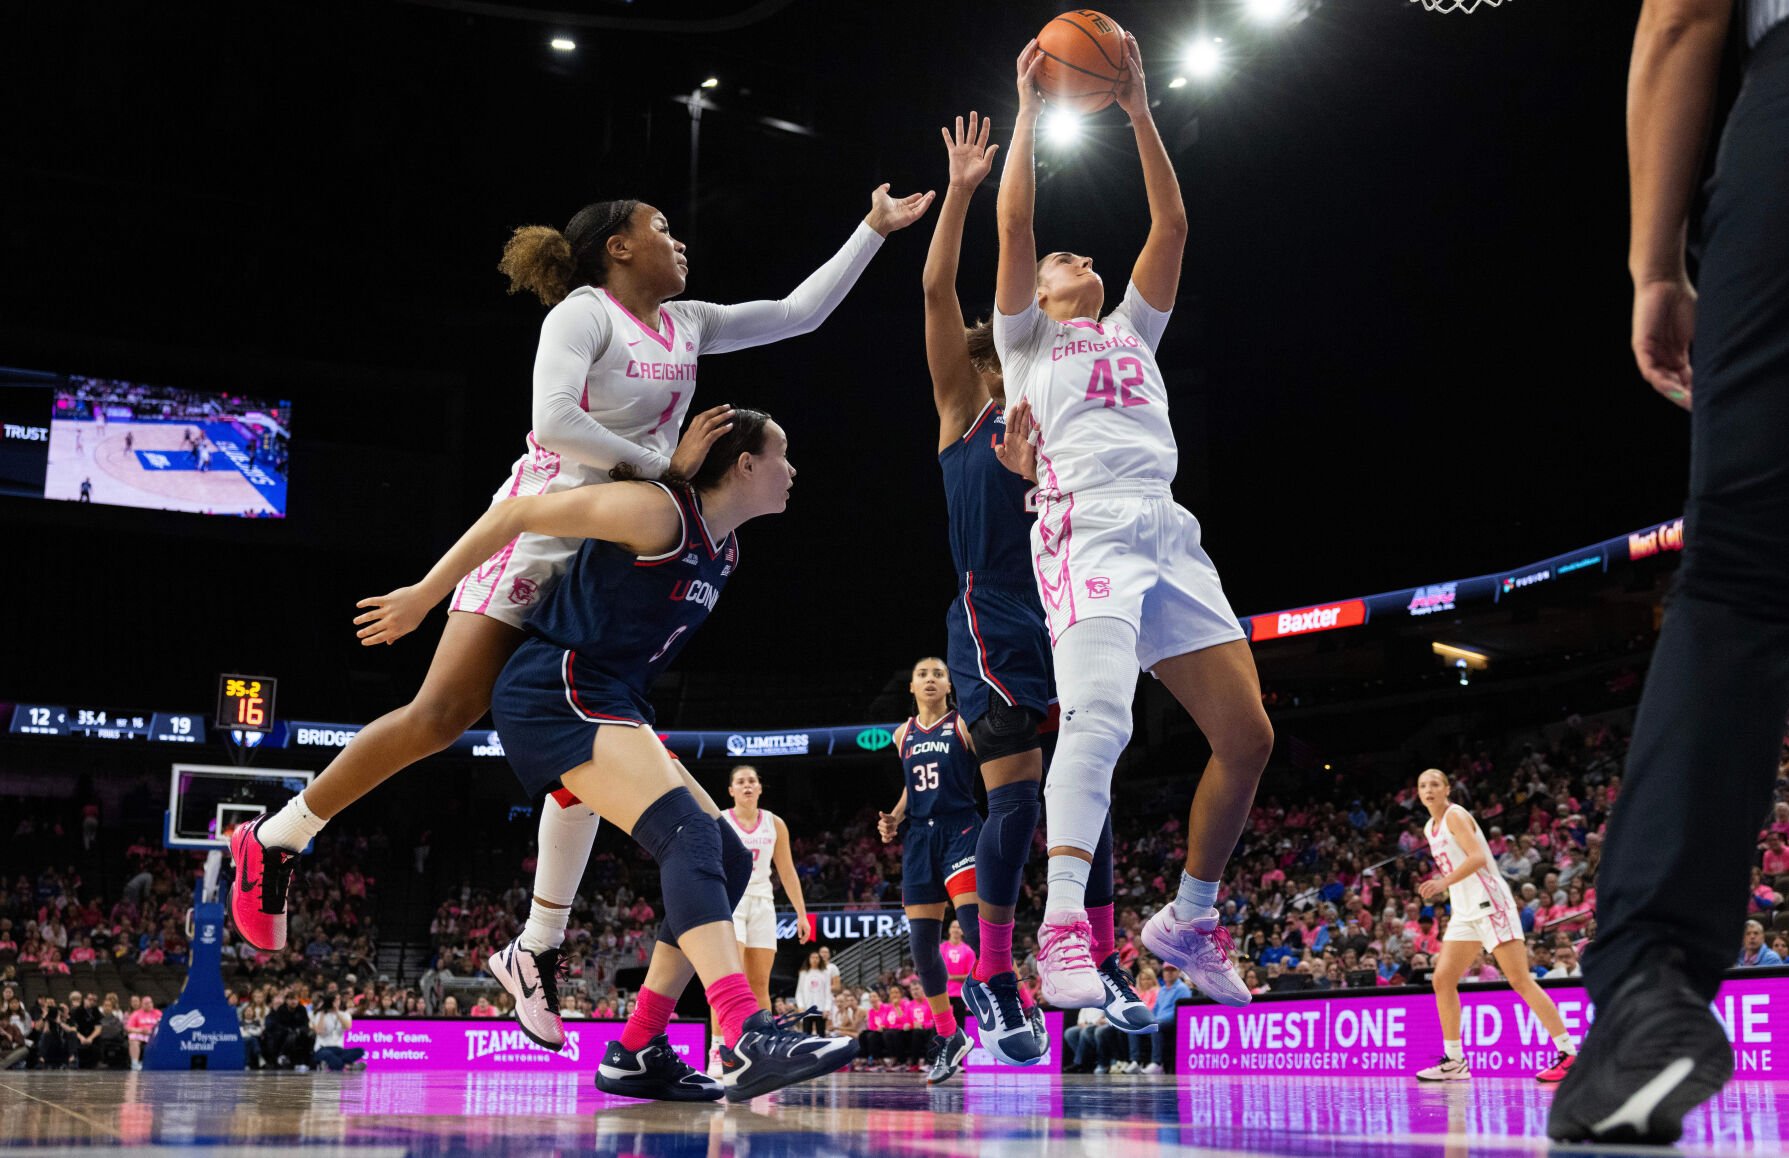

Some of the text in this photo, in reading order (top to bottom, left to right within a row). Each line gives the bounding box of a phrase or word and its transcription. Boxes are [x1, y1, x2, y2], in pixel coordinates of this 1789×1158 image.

[1083, 356, 1151, 408] 42
[3, 424, 49, 442] TRUST
[1515, 570, 1550, 588] FUSION
[1277, 605, 1341, 635] Baxter
[238, 698, 264, 725] 16
[29, 708, 51, 726] 12
[77, 709, 107, 726] 35.4
[170, 717, 192, 735] 19
[746, 734, 809, 749] LIMITLESS
[905, 741, 950, 760] UCONN
[912, 762, 940, 792] 35
[823, 914, 911, 939] ULTRA
[192, 1030, 239, 1044] Physicians
[346, 1031, 433, 1044] Join the Team.
[1189, 1015, 1230, 1050] MD
[1238, 1011, 1321, 1050] WEST
[1334, 1007, 1407, 1048] ONE
[180, 1040, 216, 1051] Mutual
[382, 1048, 429, 1061] Mentor.
[493, 1054, 551, 1063] MENTORING
[1188, 1053, 1229, 1069] ORTHO
[1240, 1052, 1348, 1069] NEUROSURGERY
[1361, 1052, 1406, 1069] SPINE
